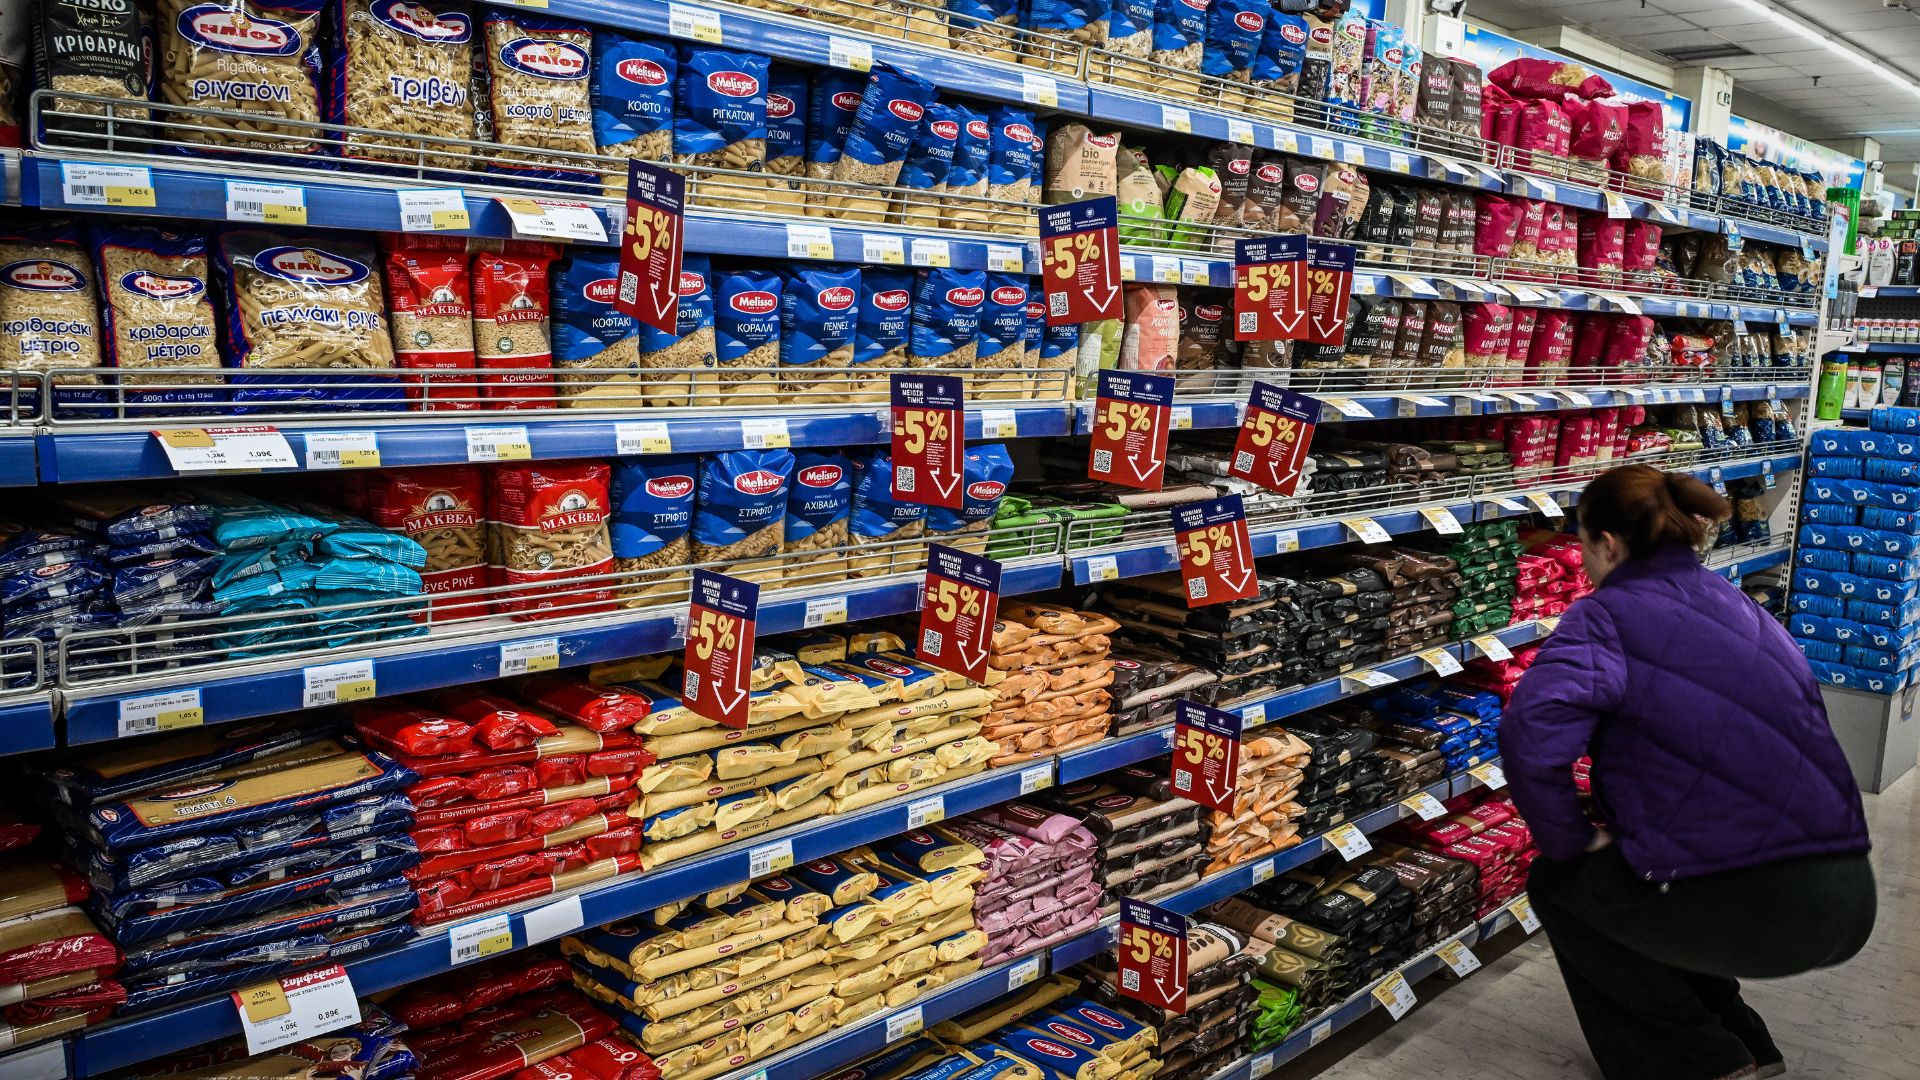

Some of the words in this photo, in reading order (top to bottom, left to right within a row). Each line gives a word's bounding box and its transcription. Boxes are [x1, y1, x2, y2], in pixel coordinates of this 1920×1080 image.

[199, 23, 281, 44] ΗΛΙΟΣ
[54, 35, 140, 61] ΚΡΙΘΑΡΑΚΙ
[522, 54, 582, 68] ΗΛΙΟΣ
[626, 64, 662, 79] Melissa
[716, 76, 753, 92] Melissa
[1428, 77, 1450, 88] MISK
[193, 79, 290, 102] ριγατόνι
[507, 104, 553, 120] κοφτό
[628, 99, 661, 114] ΚΟΦΤΟ
[895, 103, 921, 119] Melissa
[713, 108, 755, 122] ΡΙΓΚΑΤΟΝΙ
[1081, 147, 1100, 159] bio
[626, 206, 670, 260] -5%
[1045, 233, 1100, 279] -5%
[278, 261, 350, 276] ΗΛΙΟΣ
[15, 272, 76, 284] ΗΛΙΟΣ
[1238, 264, 1291, 301] -5%
[739, 296, 773, 308] Melissa
[825, 292, 852, 304] Melissa
[880, 293, 908, 304] Melissa
[953, 290, 982, 302] Melissa
[998, 290, 1023, 301] Melissa
[259, 306, 340, 327] πεννάκι
[346, 308, 380, 330] ριγέ
[416, 306, 468, 319] ΜΑΚΒΕΛ
[676, 309, 703, 320] ΟΦΤΑΚΙ
[3, 317, 93, 337] κριθαράκι
[592, 317, 631, 329] ΚΟΦΤΑΚΙ
[737, 323, 773, 333] ΚΟΡΑΛΛΙ
[823, 321, 849, 331] ΠΕΝΝΕΣ
[879, 321, 905, 331] ΠΕΝΝΕΣ
[947, 318, 979, 328] ΑΧΙΒΑΔΑ
[994, 317, 1023, 327] ΑΧΙΒΑΔΑ
[129, 323, 211, 341] κριθαράκι
[20, 339, 81, 355] μέτριο
[147, 343, 202, 361] μέτριο
[1097, 401, 1151, 441] -5%
[895, 410, 948, 454] -5%
[1245, 411, 1296, 446] -5%
[248, 450, 272, 458] 1,09€
[806, 470, 838, 481] Melissa
[654, 480, 688, 492] Melissa
[742, 477, 780, 489] Melissa
[973, 485, 1001, 496] Melissa
[739, 505, 773, 517] ΣΤΡΙΦΤΟ
[804, 499, 839, 511] ΑΧΙΒΑΔΑ
[893, 507, 921, 516] ΠΕΝΝΕΣ
[965, 507, 992, 516] ΠΕΝΝΕΣ
[407, 513, 476, 532] ΜΑΚΒΕΛ
[543, 512, 601, 530] ΜΑΚΒΕΛ
[653, 512, 688, 523] ΣΤΡΙΦΤΟ
[1181, 526, 1232, 567] -5%
[419, 580, 449, 592] ένες
[452, 576, 475, 588] Ριγέ
[927, 579, 980, 622] -5%
[690, 610, 735, 660] -5%
[1177, 729, 1224, 764] -5%
[175, 801, 222, 816] ΣΠΑΓΕΤΙ
[224, 796, 236, 805] 6
[440, 809, 476, 819] Σπαγγετίνη
[448, 903, 485, 916] Σπαγγετίνη
[1123, 927, 1172, 963] -5%
[283, 965, 339, 988] Συμφέρει!
[252, 991, 271, 999] -15%
[280, 1022, 298, 1032] 1,05€
[318, 1009, 339, 1021] 0,89€
[1035, 1042, 1067, 1056] Melissa
